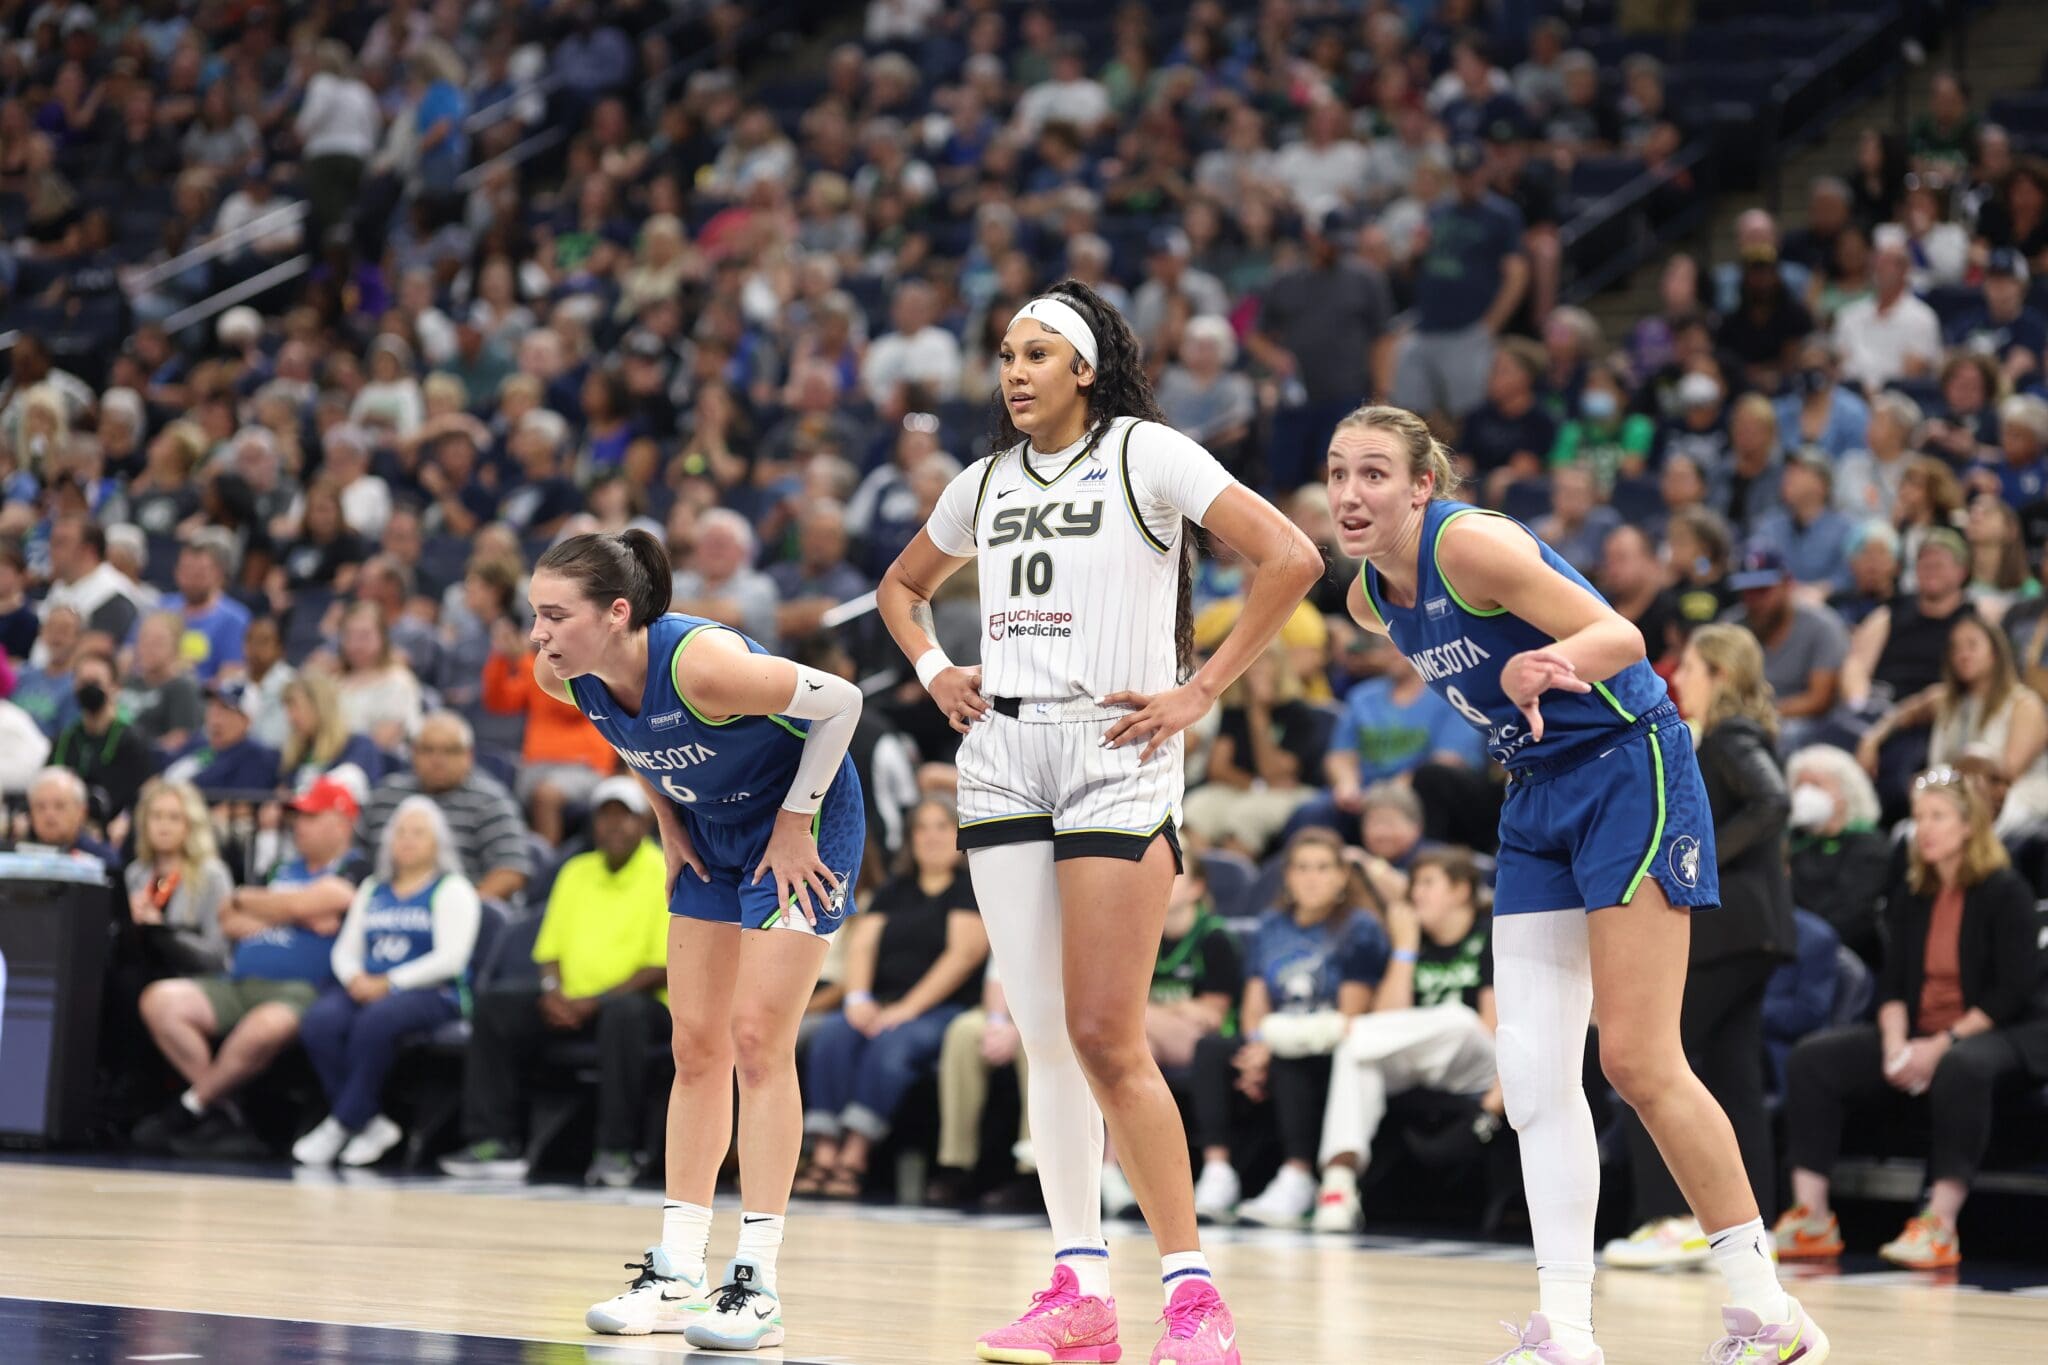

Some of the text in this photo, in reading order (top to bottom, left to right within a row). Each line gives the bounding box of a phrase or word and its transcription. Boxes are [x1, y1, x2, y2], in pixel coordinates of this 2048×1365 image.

[987, 500, 1104, 547] SKY
[1010, 551, 1054, 598] 10
[1008, 609, 1073, 624] UChicago
[1008, 624, 1072, 638] Medicine
[1407, 635, 1492, 683] NNESOTA
[1446, 684, 1493, 725] 8
[609, 742, 718, 770] NNESOTA
[661, 775, 698, 802] 6
